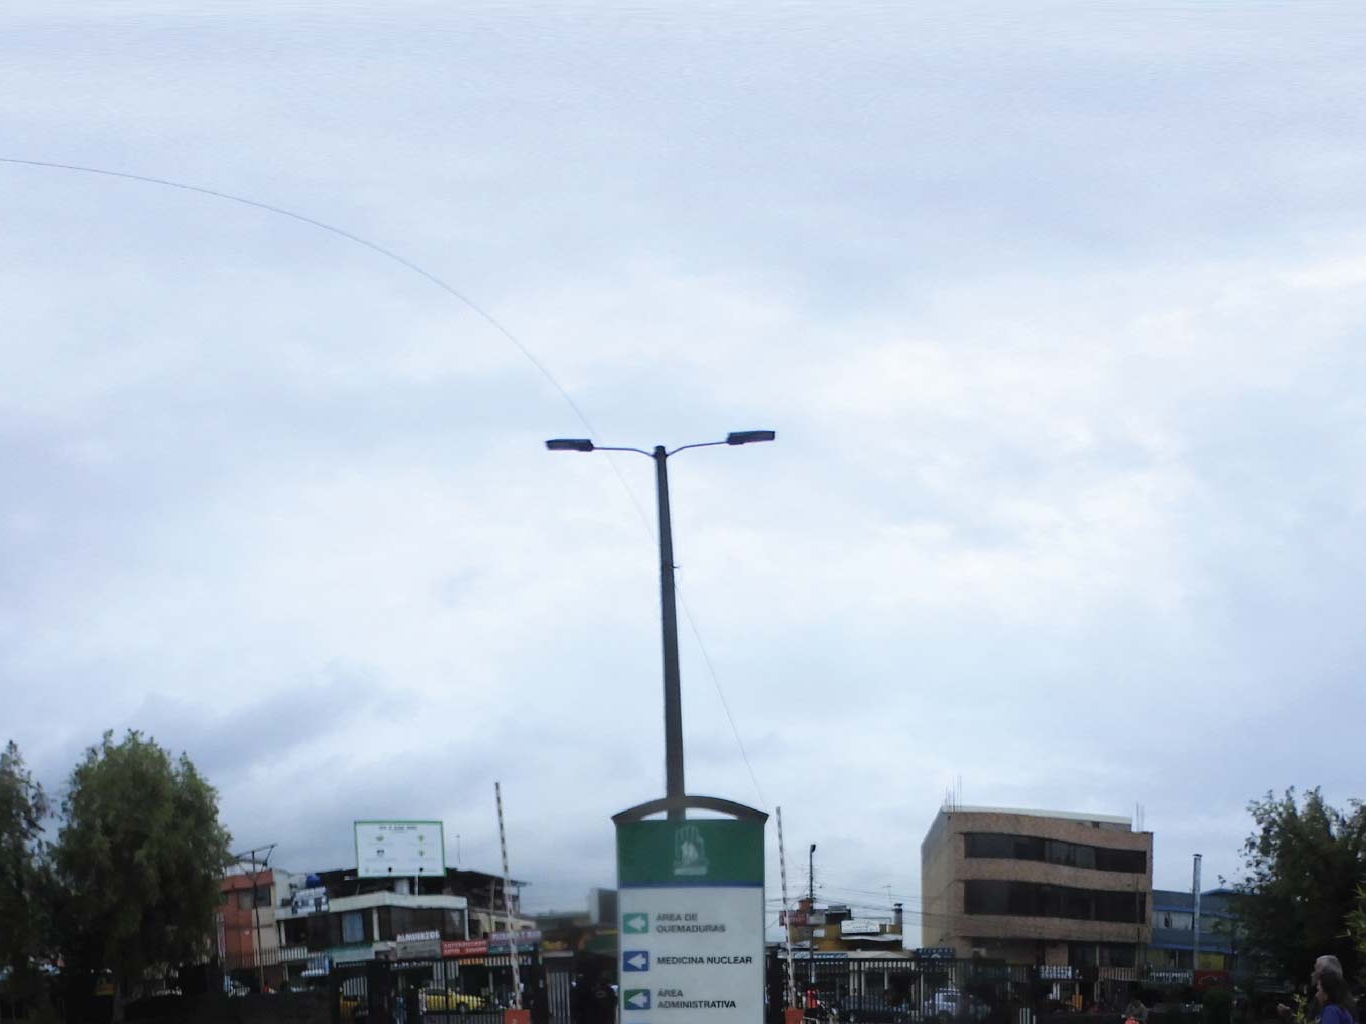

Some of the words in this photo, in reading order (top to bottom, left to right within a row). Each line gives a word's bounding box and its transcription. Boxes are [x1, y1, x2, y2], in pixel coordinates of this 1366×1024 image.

[685, 912, 698, 921] DE
[656, 924, 726, 933] QUEMADURAS
[657, 957, 704, 965] MEDICINA
[706, 956, 753, 964] NUCLEAR
[657, 1000, 737, 1009] ADMINISTRATIVA
